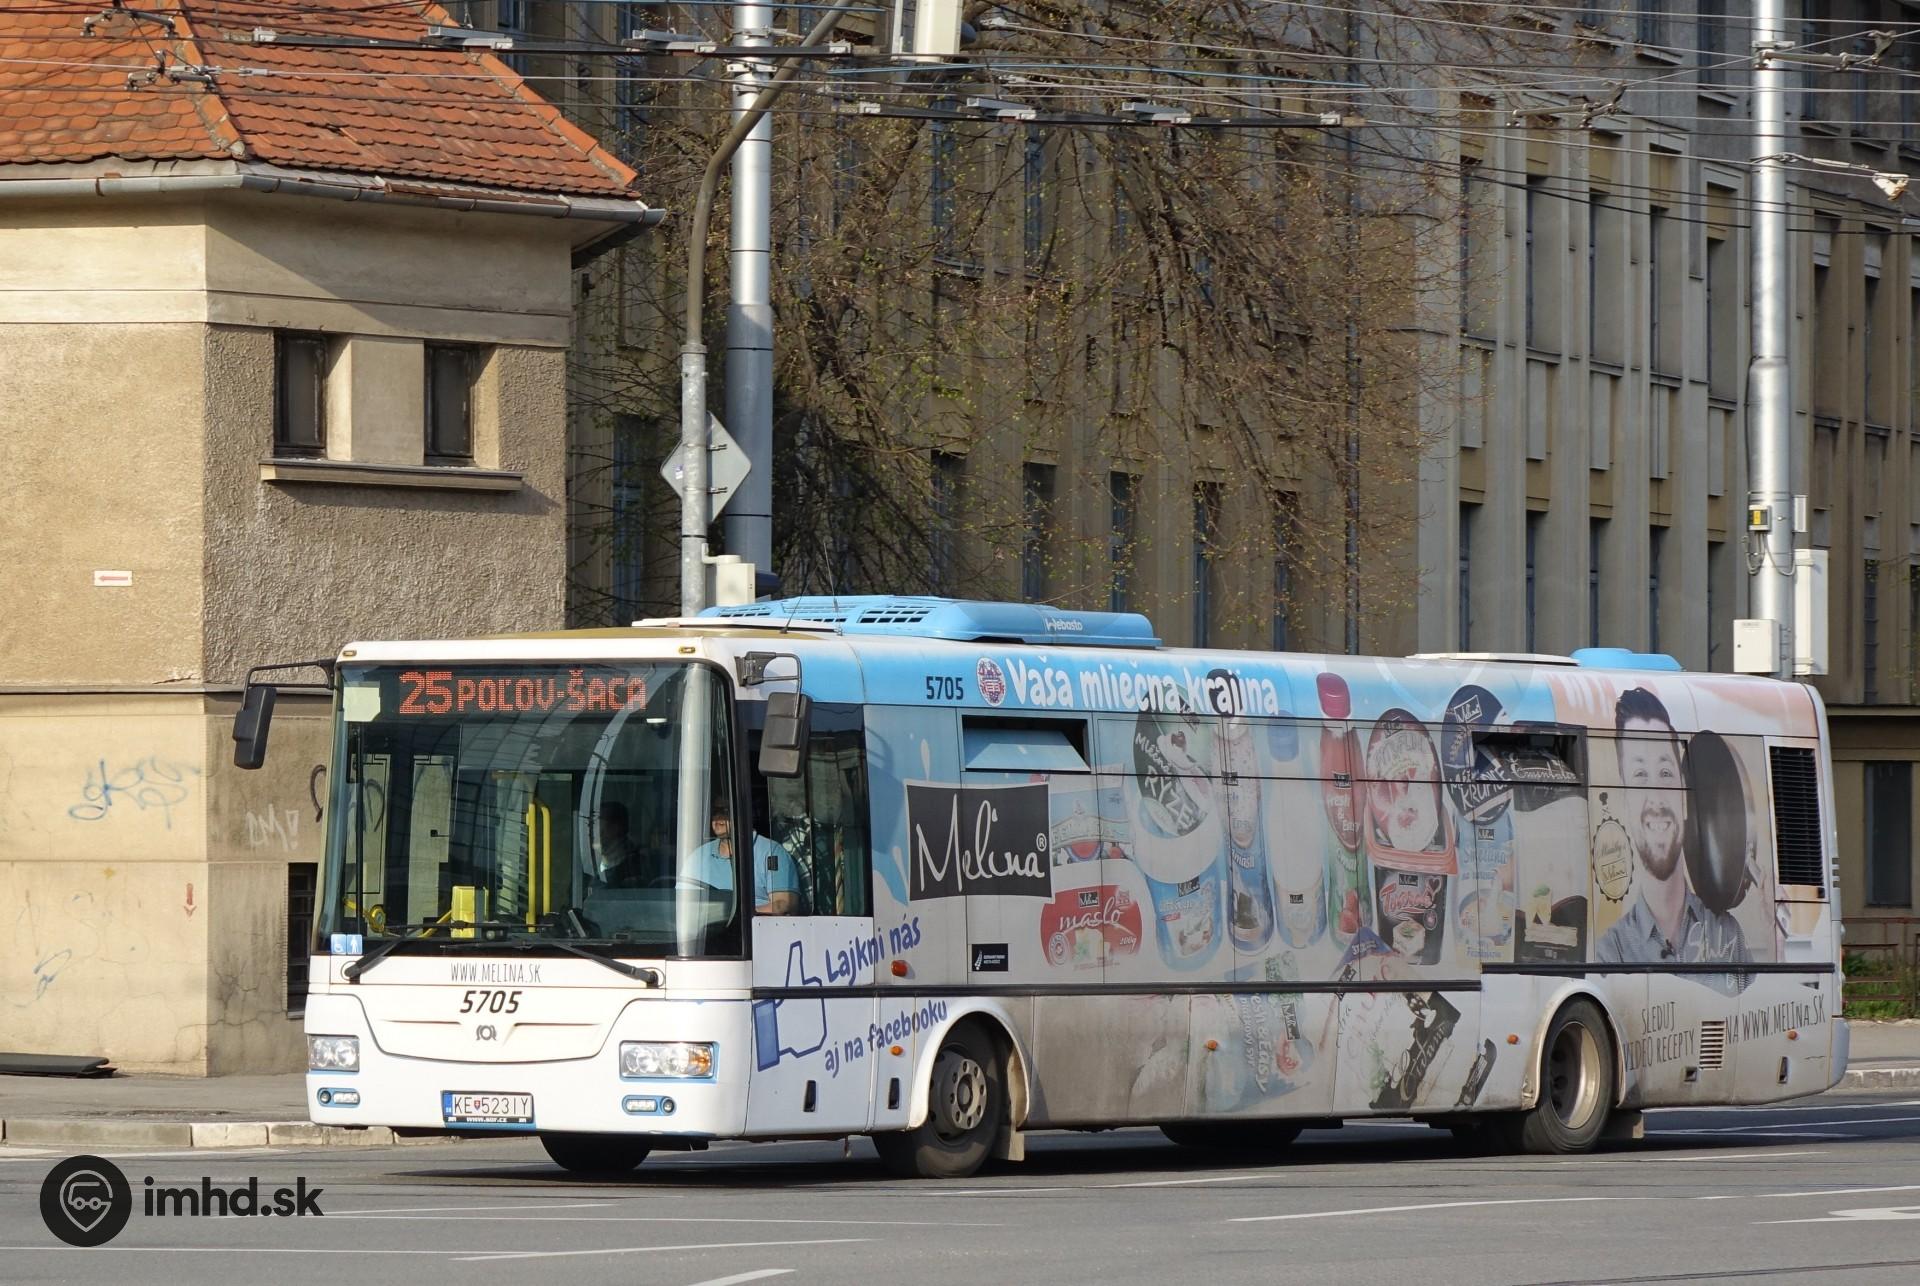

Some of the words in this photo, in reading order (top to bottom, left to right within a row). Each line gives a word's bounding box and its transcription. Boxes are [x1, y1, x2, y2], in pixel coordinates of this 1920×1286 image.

[1044, 618, 1083, 631] Webasto
[399, 671, 452, 714] 25
[926, 676, 964, 700] 5705
[1006, 655, 1073, 709] Vaša
[1079, 659, 1180, 712] mliečna
[1183, 666, 1279, 716] krajina
[1060, 898, 1126, 930] maslo
[825, 928, 885, 985] Lajkni
[889, 914, 921, 954] nás
[451, 962, 542, 983] WWW.MELINA.SK
[459, 990, 522, 1013] 5705
[1623, 1036, 1653, 1073] VIDEO
[1656, 1029, 1695, 1063] RECEPTY
[1725, 1015, 1739, 1045] NA
[1742, 993, 1826, 1042] WWW.MELINA.SK
[1641, 1002, 1676, 1035] SLEDUJ
[825, 1041, 839, 1078] aj
[844, 1036, 864, 1063] na
[867, 1000, 948, 1052] facebooku
[454, 1096, 472, 1114] KE
